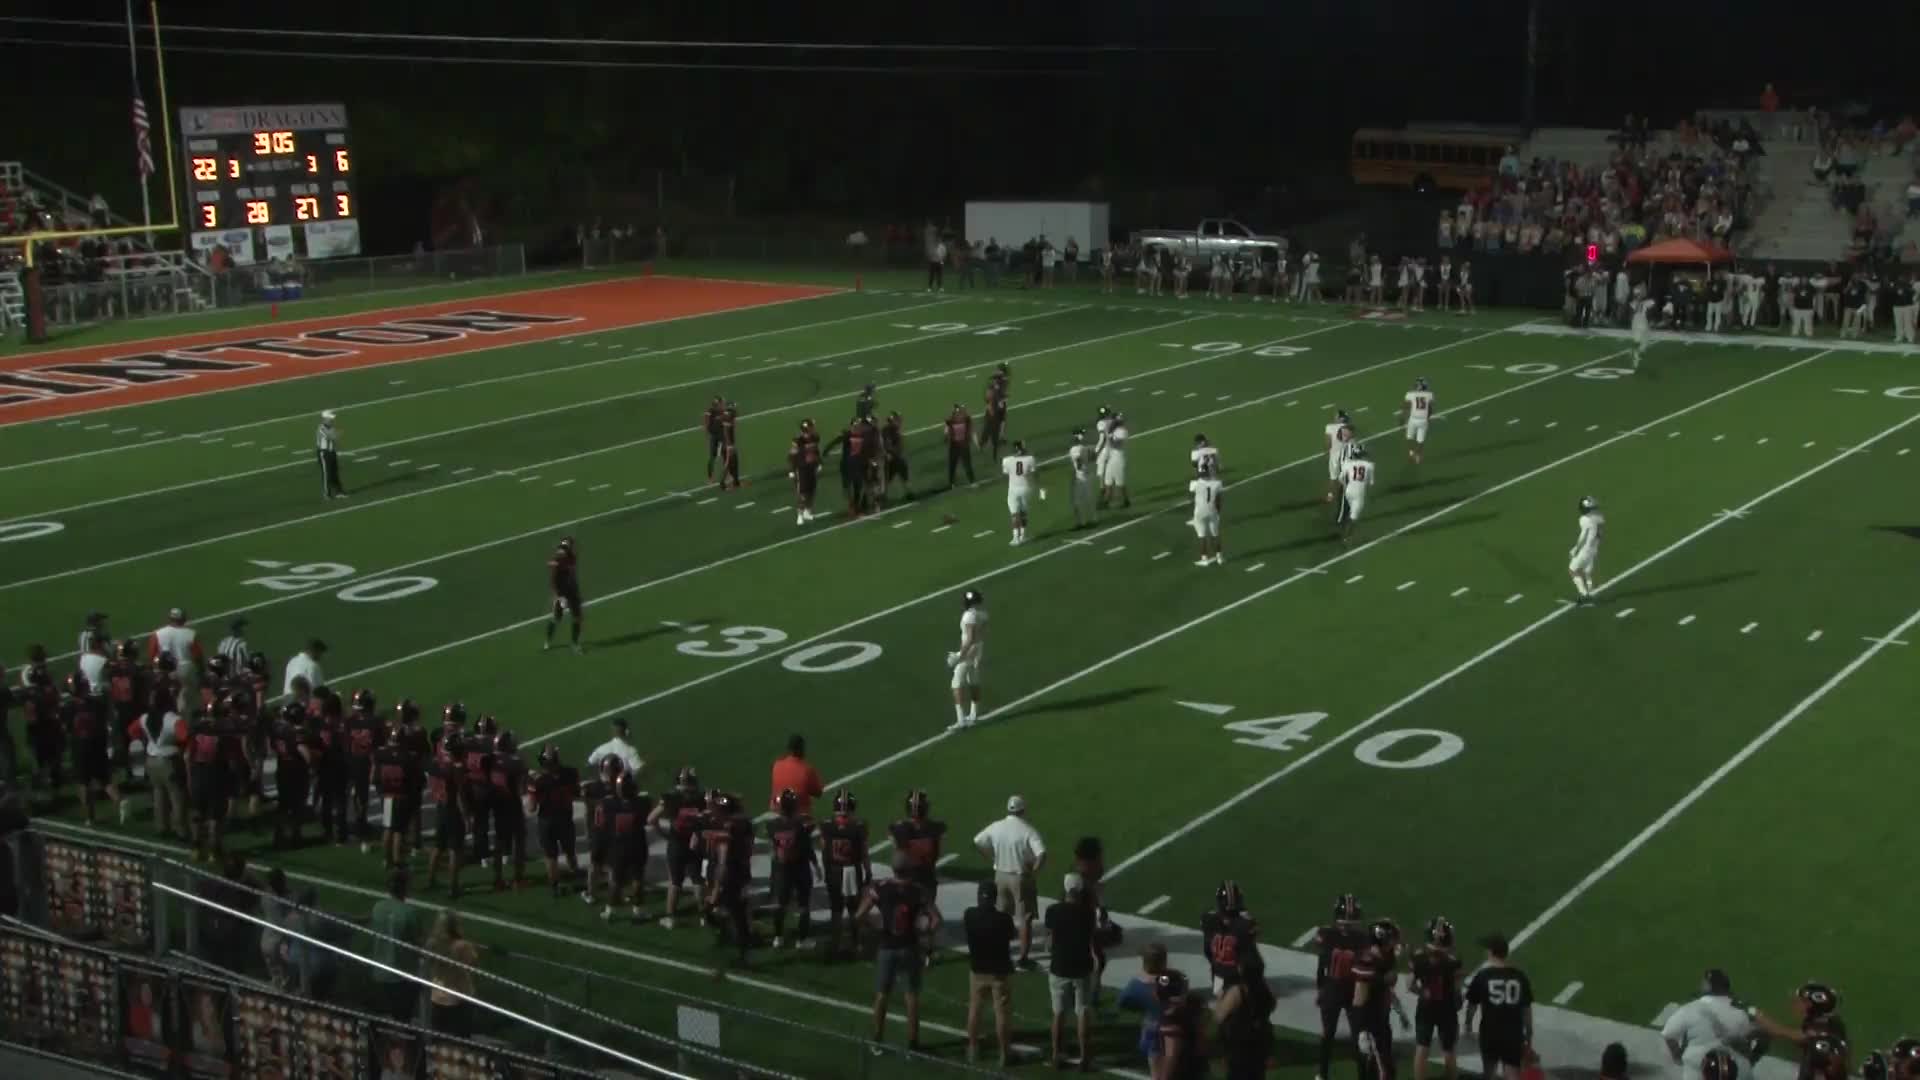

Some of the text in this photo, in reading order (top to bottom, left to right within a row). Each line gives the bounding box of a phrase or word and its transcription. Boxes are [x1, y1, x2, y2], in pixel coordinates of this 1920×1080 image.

[192, 157, 217, 180] 22
[228, 159, 240, 178] 3
[306, 155, 317, 172] 3
[336, 150, 349, 171] 6
[203, 205, 216, 227] 3
[295, 197, 319, 220] 27
[336, 195, 349, 216] 3
[1487, 979, 1521, 1005] 50
